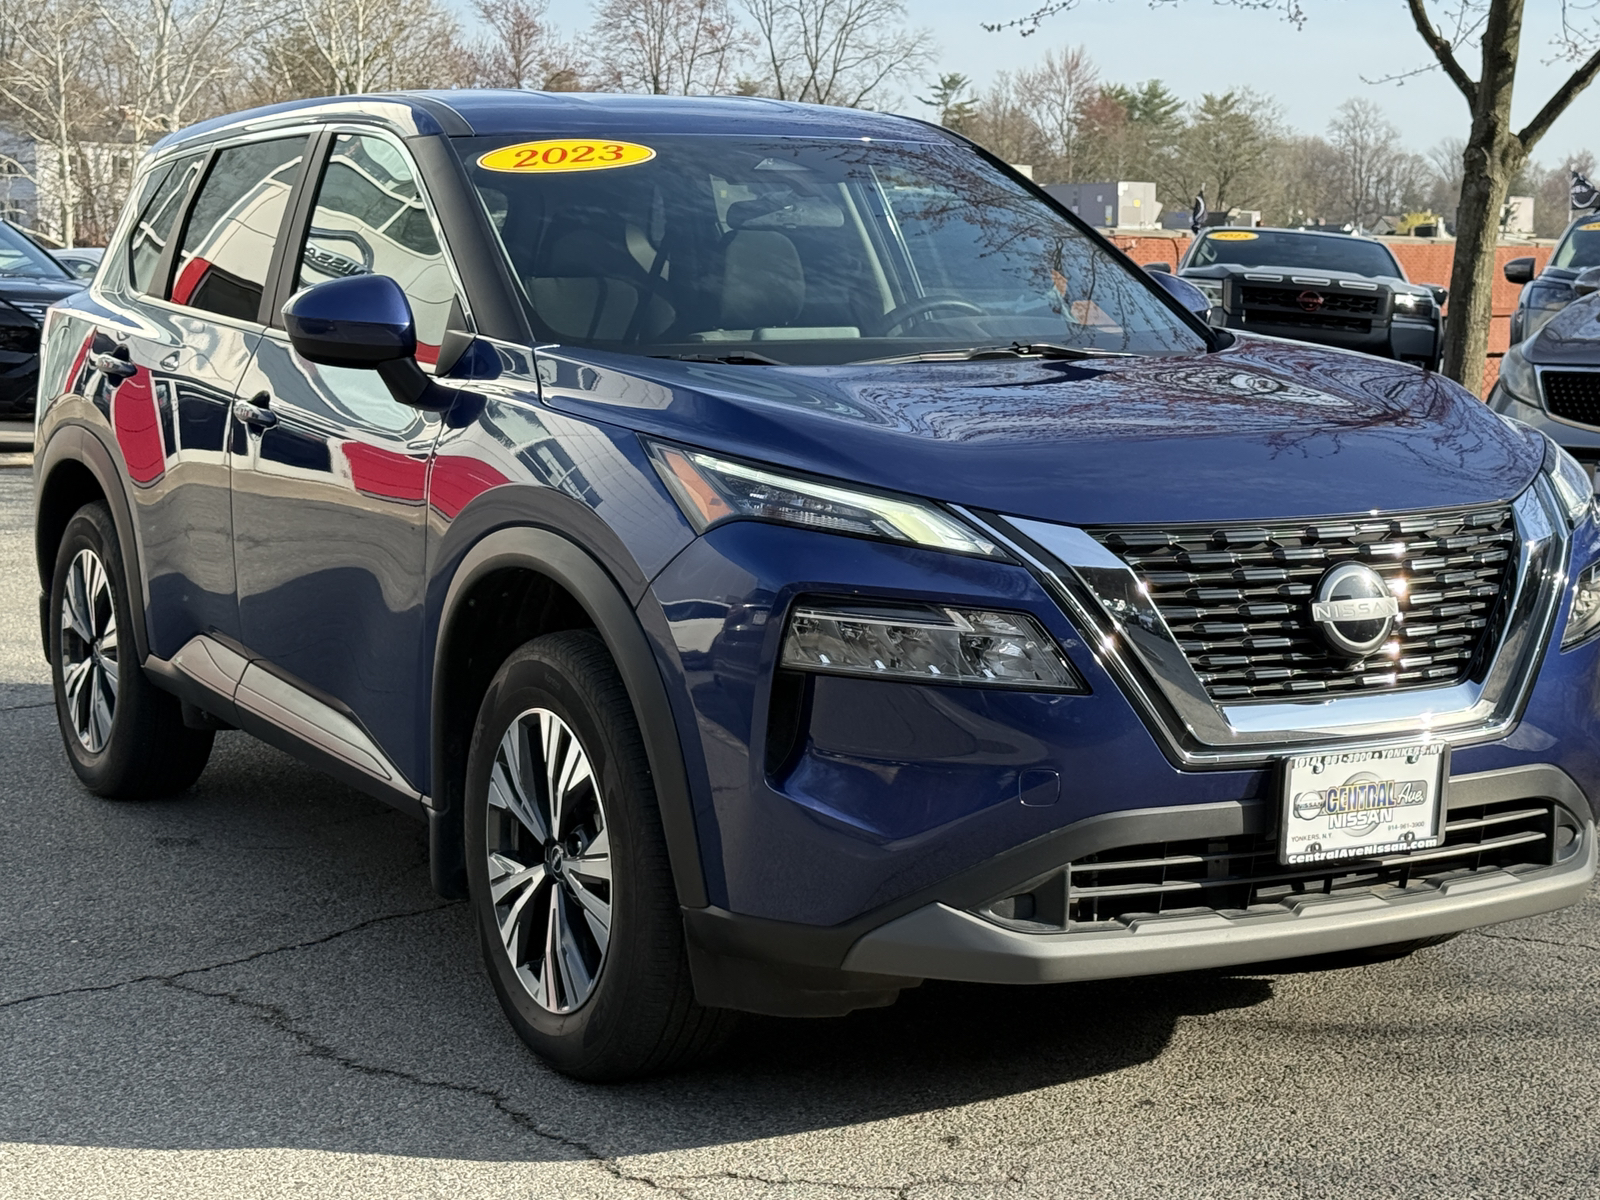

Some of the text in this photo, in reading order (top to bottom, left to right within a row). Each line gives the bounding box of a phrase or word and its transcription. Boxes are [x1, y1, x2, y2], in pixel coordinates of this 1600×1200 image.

[512, 144, 624, 169] 2023
[1315, 602, 1395, 619] NISSAN
[1297, 801, 1323, 809] NISSAN
[1326, 780, 1397, 813] CENTRAL
[1328, 807, 1393, 830] NISSAN
